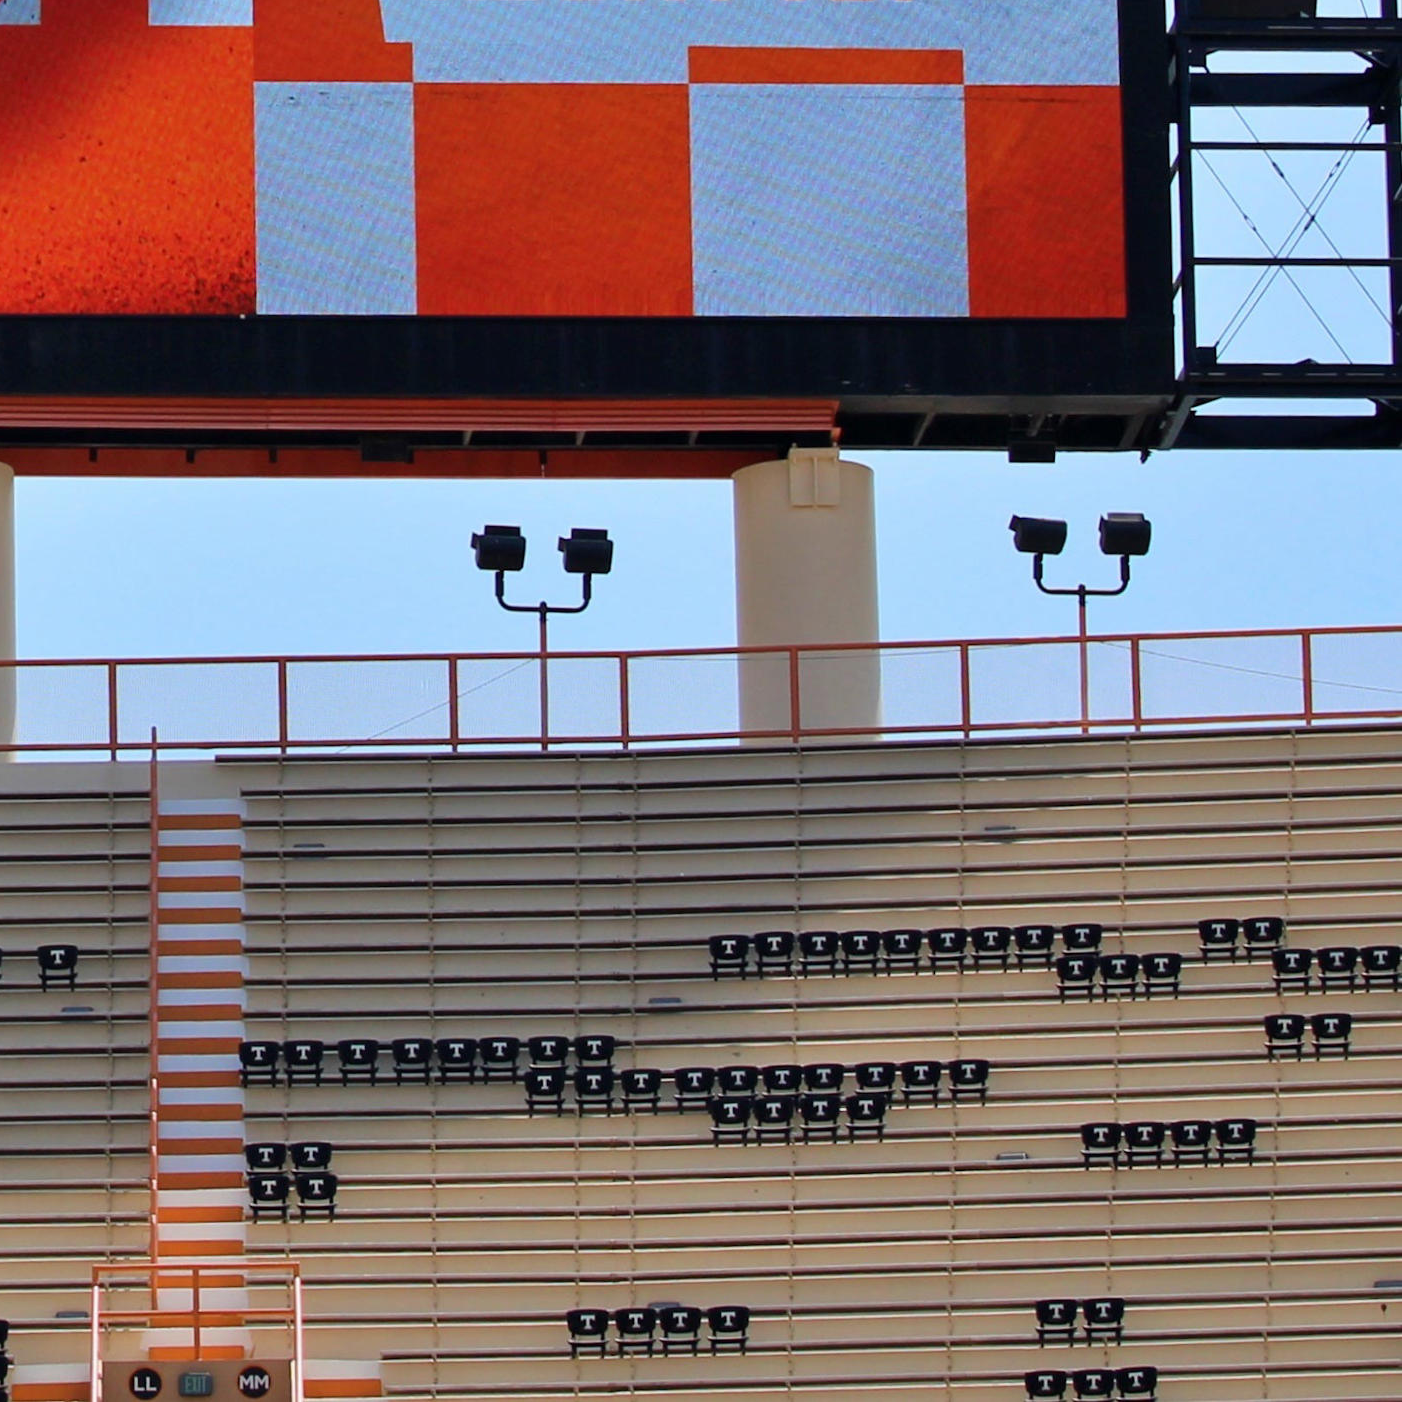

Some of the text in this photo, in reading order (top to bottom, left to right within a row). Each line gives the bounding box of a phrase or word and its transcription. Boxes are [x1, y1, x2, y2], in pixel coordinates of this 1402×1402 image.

[1075, 929, 1089, 942] T
[1212, 924, 1225, 937] T
[1256, 922, 1269, 936] T
[812, 937, 826, 950] T
[895, 935, 909, 948] T
[941, 933, 955, 946] T
[1027, 930, 1041, 943] T
[722, 940, 736, 953] T
[768, 937, 781, 951] T
[51, 950, 64, 963] T
[1374, 951, 1388, 964] T
[1154, 958, 1168, 972] T
[1278, 1019, 1292, 1033] T
[1324, 1019, 1338, 1033] T
[251, 1047, 265, 1060] T
[296, 1046, 310, 1059] T
[351, 1045, 365, 1058] T
[405, 1044, 419, 1057] T
[493, 1042, 507, 1056] T
[588, 1041, 601, 1054] T
[775, 1070, 789, 1084] T
[914, 1066, 928, 1079] T
[962, 1064, 975, 1078] T
[537, 1076, 552, 1089] T
[634, 1074, 648, 1088] T
[688, 1072, 702, 1086] T
[767, 1103, 781, 1117] T
[859, 1100, 873, 1114] T
[1094, 1128, 1108, 1142] T
[1138, 1127, 1152, 1140] T
[1184, 1125, 1198, 1139] T
[1229, 1124, 1243, 1137] T
[262, 1181, 276, 1194] T
[309, 1180, 323, 1194] T
[1049, 1304, 1063, 1318] T
[1096, 1303, 1110, 1317] T
[581, 1315, 595, 1329] T
[629, 1314, 643, 1328] T
[673, 1312, 687, 1327] T
[721, 1312, 735, 1326] T
[133, 1376, 157, 1391] LL
[184, 1376, 207, 1393] EXIT
[239, 1374, 269, 1389] MM
[1038, 1376, 1053, 1390] T
[1129, 1372, 1143, 1386] T
